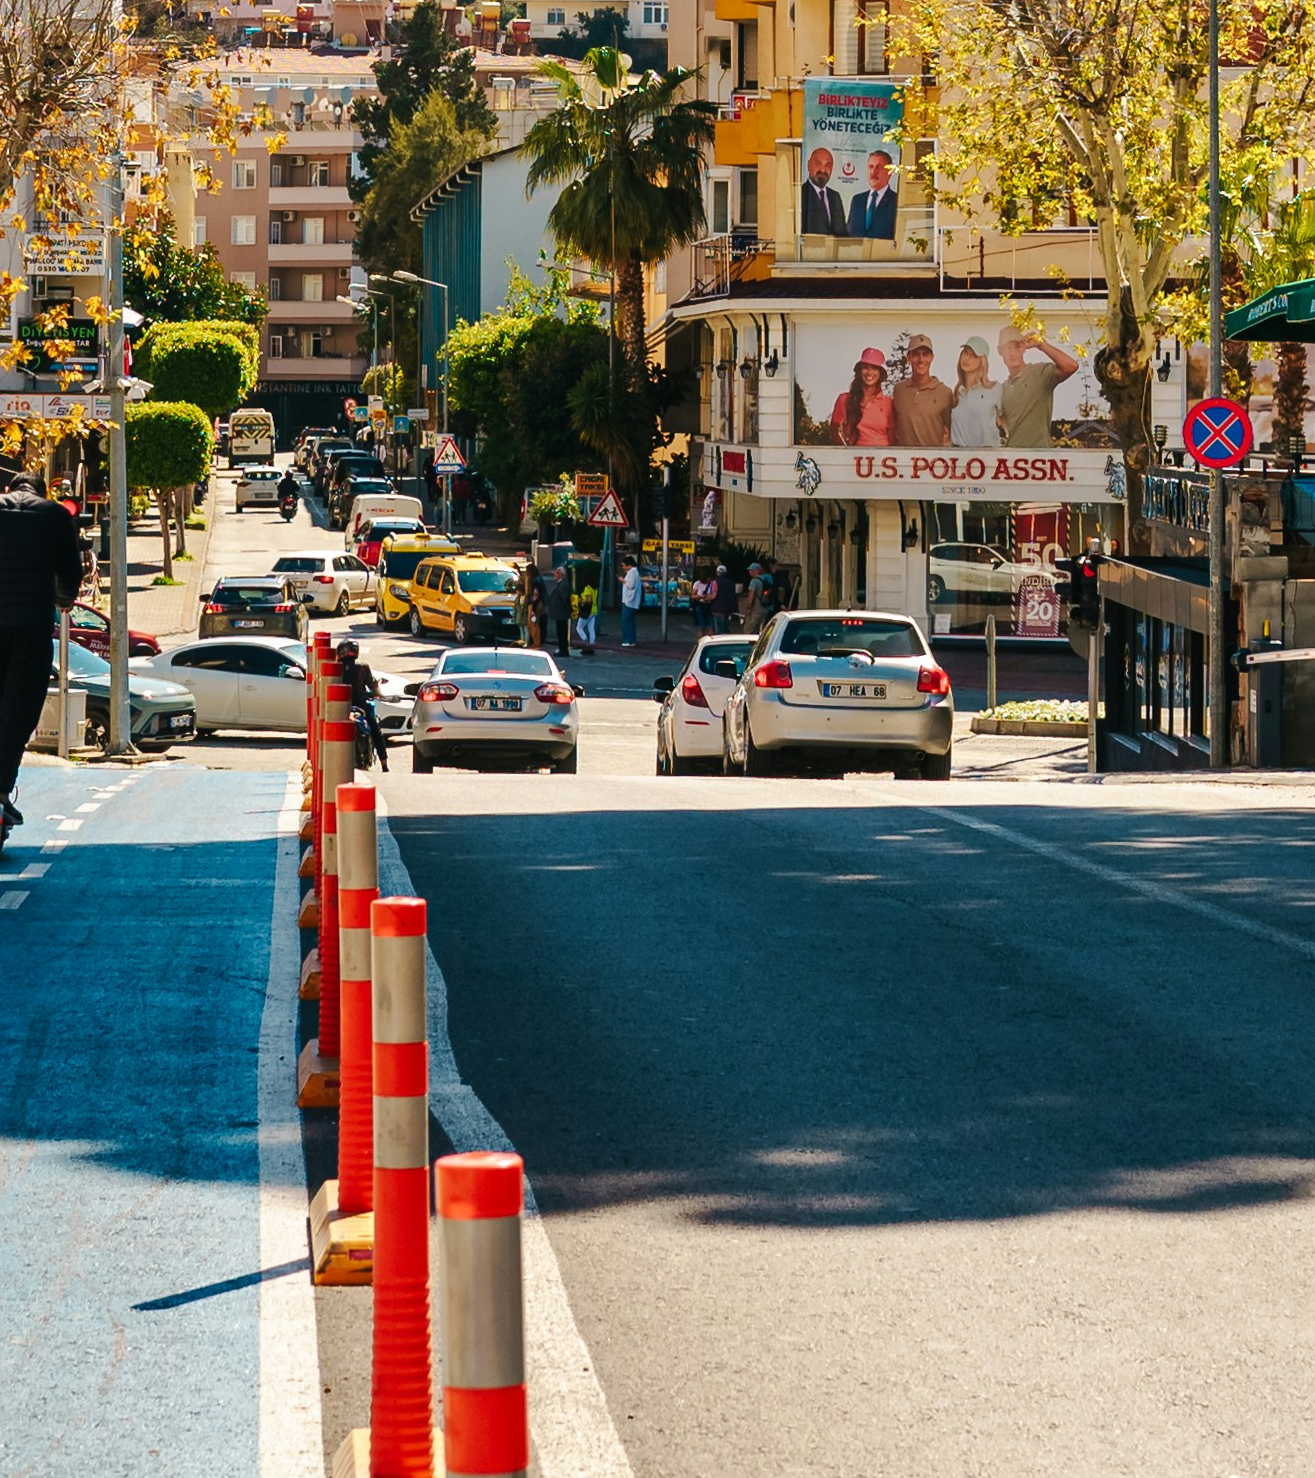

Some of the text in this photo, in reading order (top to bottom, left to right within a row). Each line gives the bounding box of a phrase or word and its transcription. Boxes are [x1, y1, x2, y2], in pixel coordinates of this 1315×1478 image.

[818, 93, 888, 109] BİRLİKTEYİZ
[827, 107, 878, 120] BİRLİKTE
[812, 117, 891, 134] YÖNETECEĞİZ
[854, 456, 1075, 481] U.S. POLO ASSN.
[941, 486, 965, 494] SINCE
[831, 686, 885, 697] 07 HEA 68
